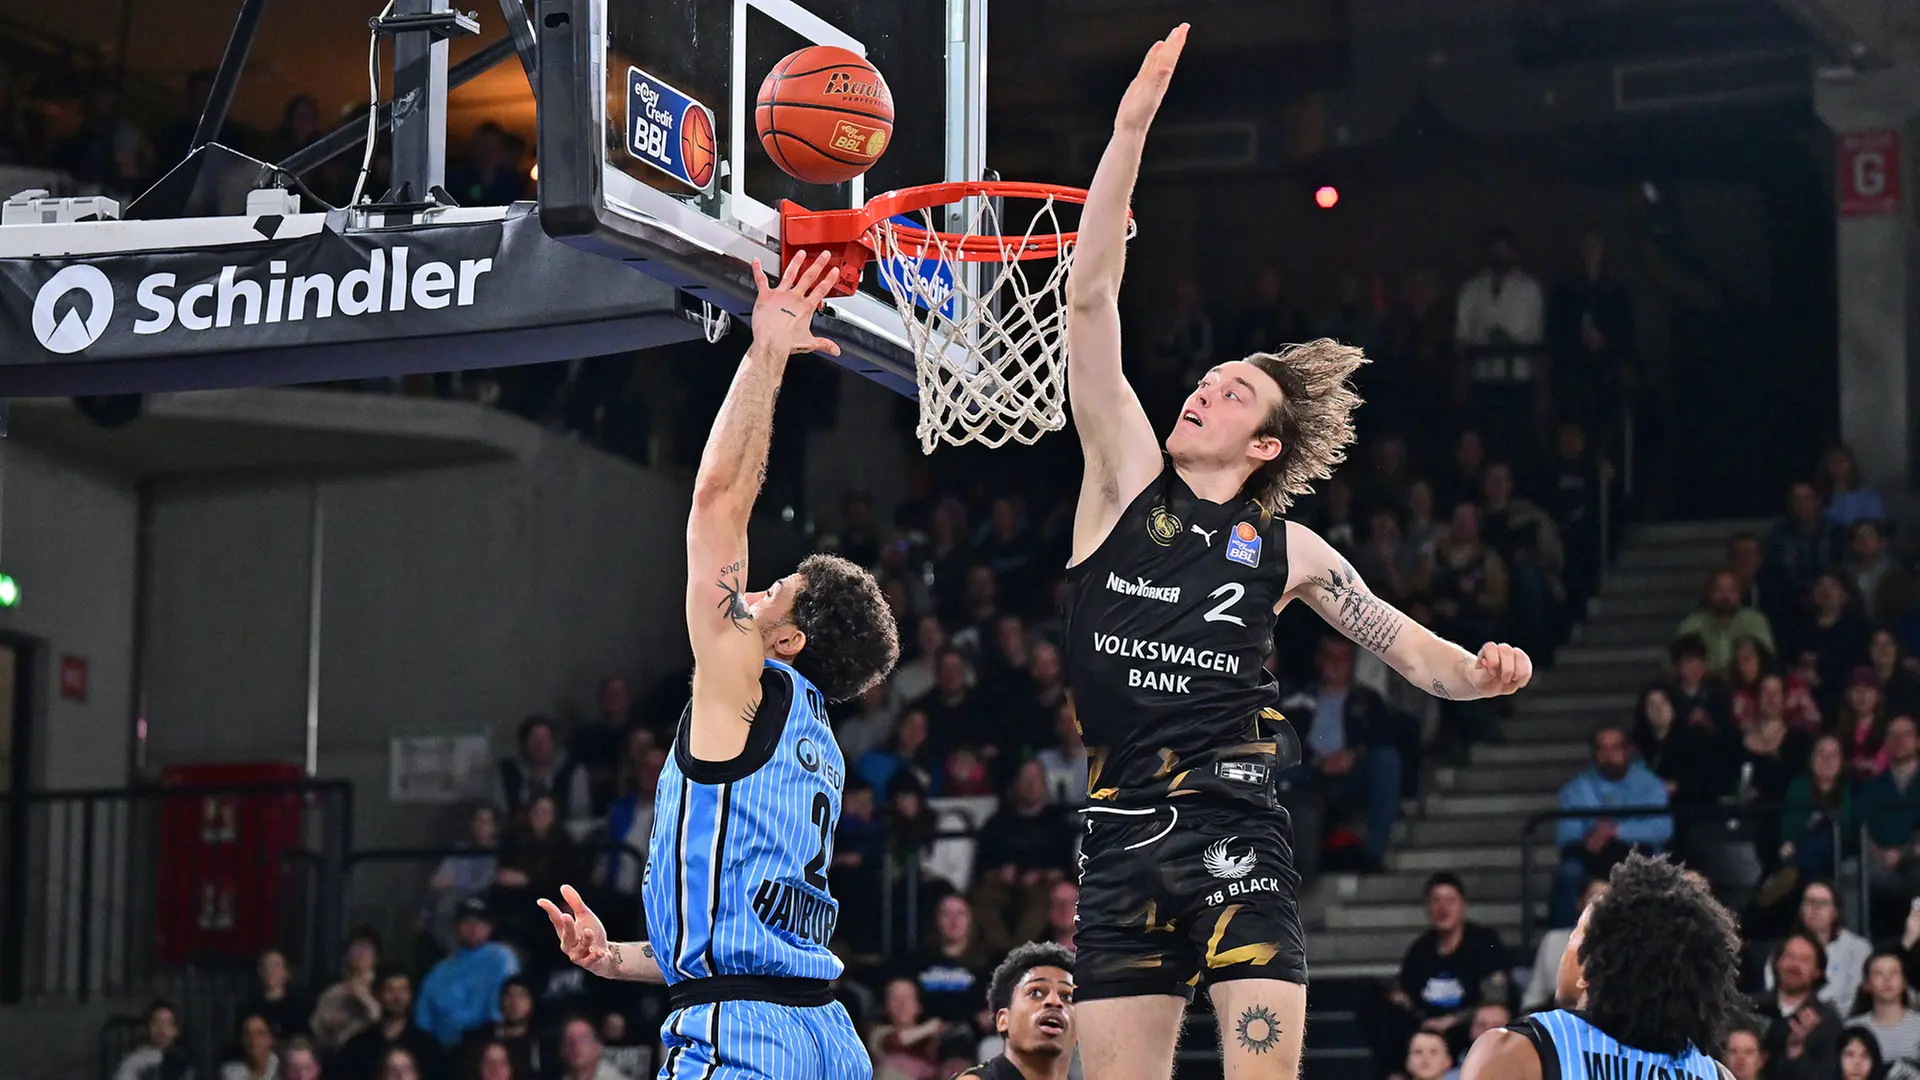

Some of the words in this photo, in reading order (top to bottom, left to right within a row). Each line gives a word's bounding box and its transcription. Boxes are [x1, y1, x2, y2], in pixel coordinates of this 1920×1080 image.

[646, 102, 673, 129] Credit
[634, 116, 672, 165] BBL
[835, 136, 861, 152] BBL
[1853, 153, 1884, 196] G
[133, 246, 492, 335] Schindler
[1230, 548, 1255, 563] BBL
[1203, 582, 1247, 627] 2
[1093, 632, 1240, 675] VOLKSWAGEN
[1128, 668, 1191, 693] BANK
[1205, 890, 1224, 906] 28
[1228, 877, 1280, 896] BLACK
